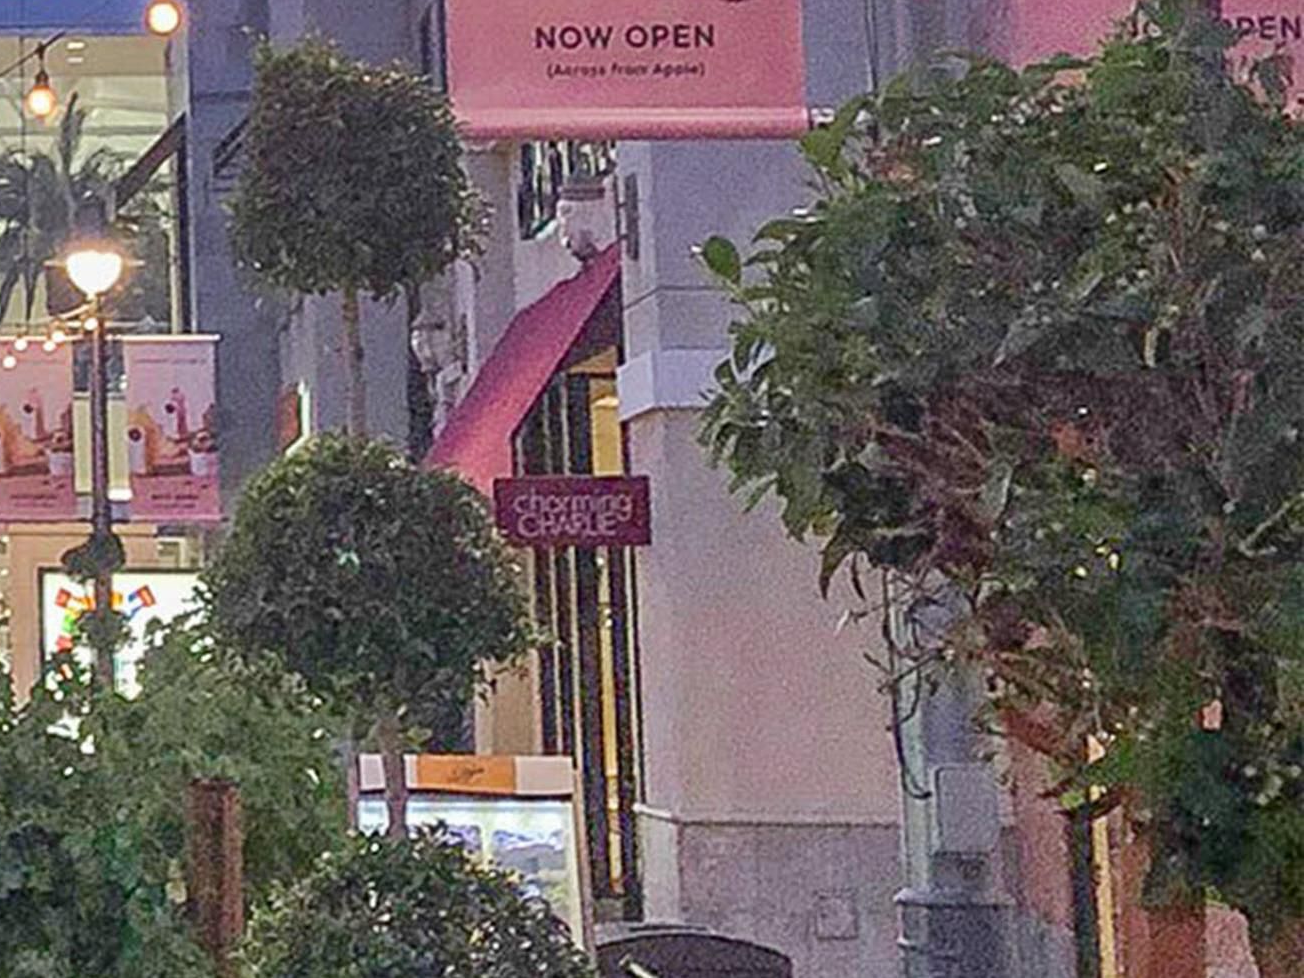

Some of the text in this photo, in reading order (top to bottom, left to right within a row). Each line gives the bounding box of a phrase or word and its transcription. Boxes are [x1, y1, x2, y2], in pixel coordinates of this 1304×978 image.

[535, 24, 715, 50] NOW OPEN
[611, 62, 648, 75] from
[513, 487, 633, 521] charming
